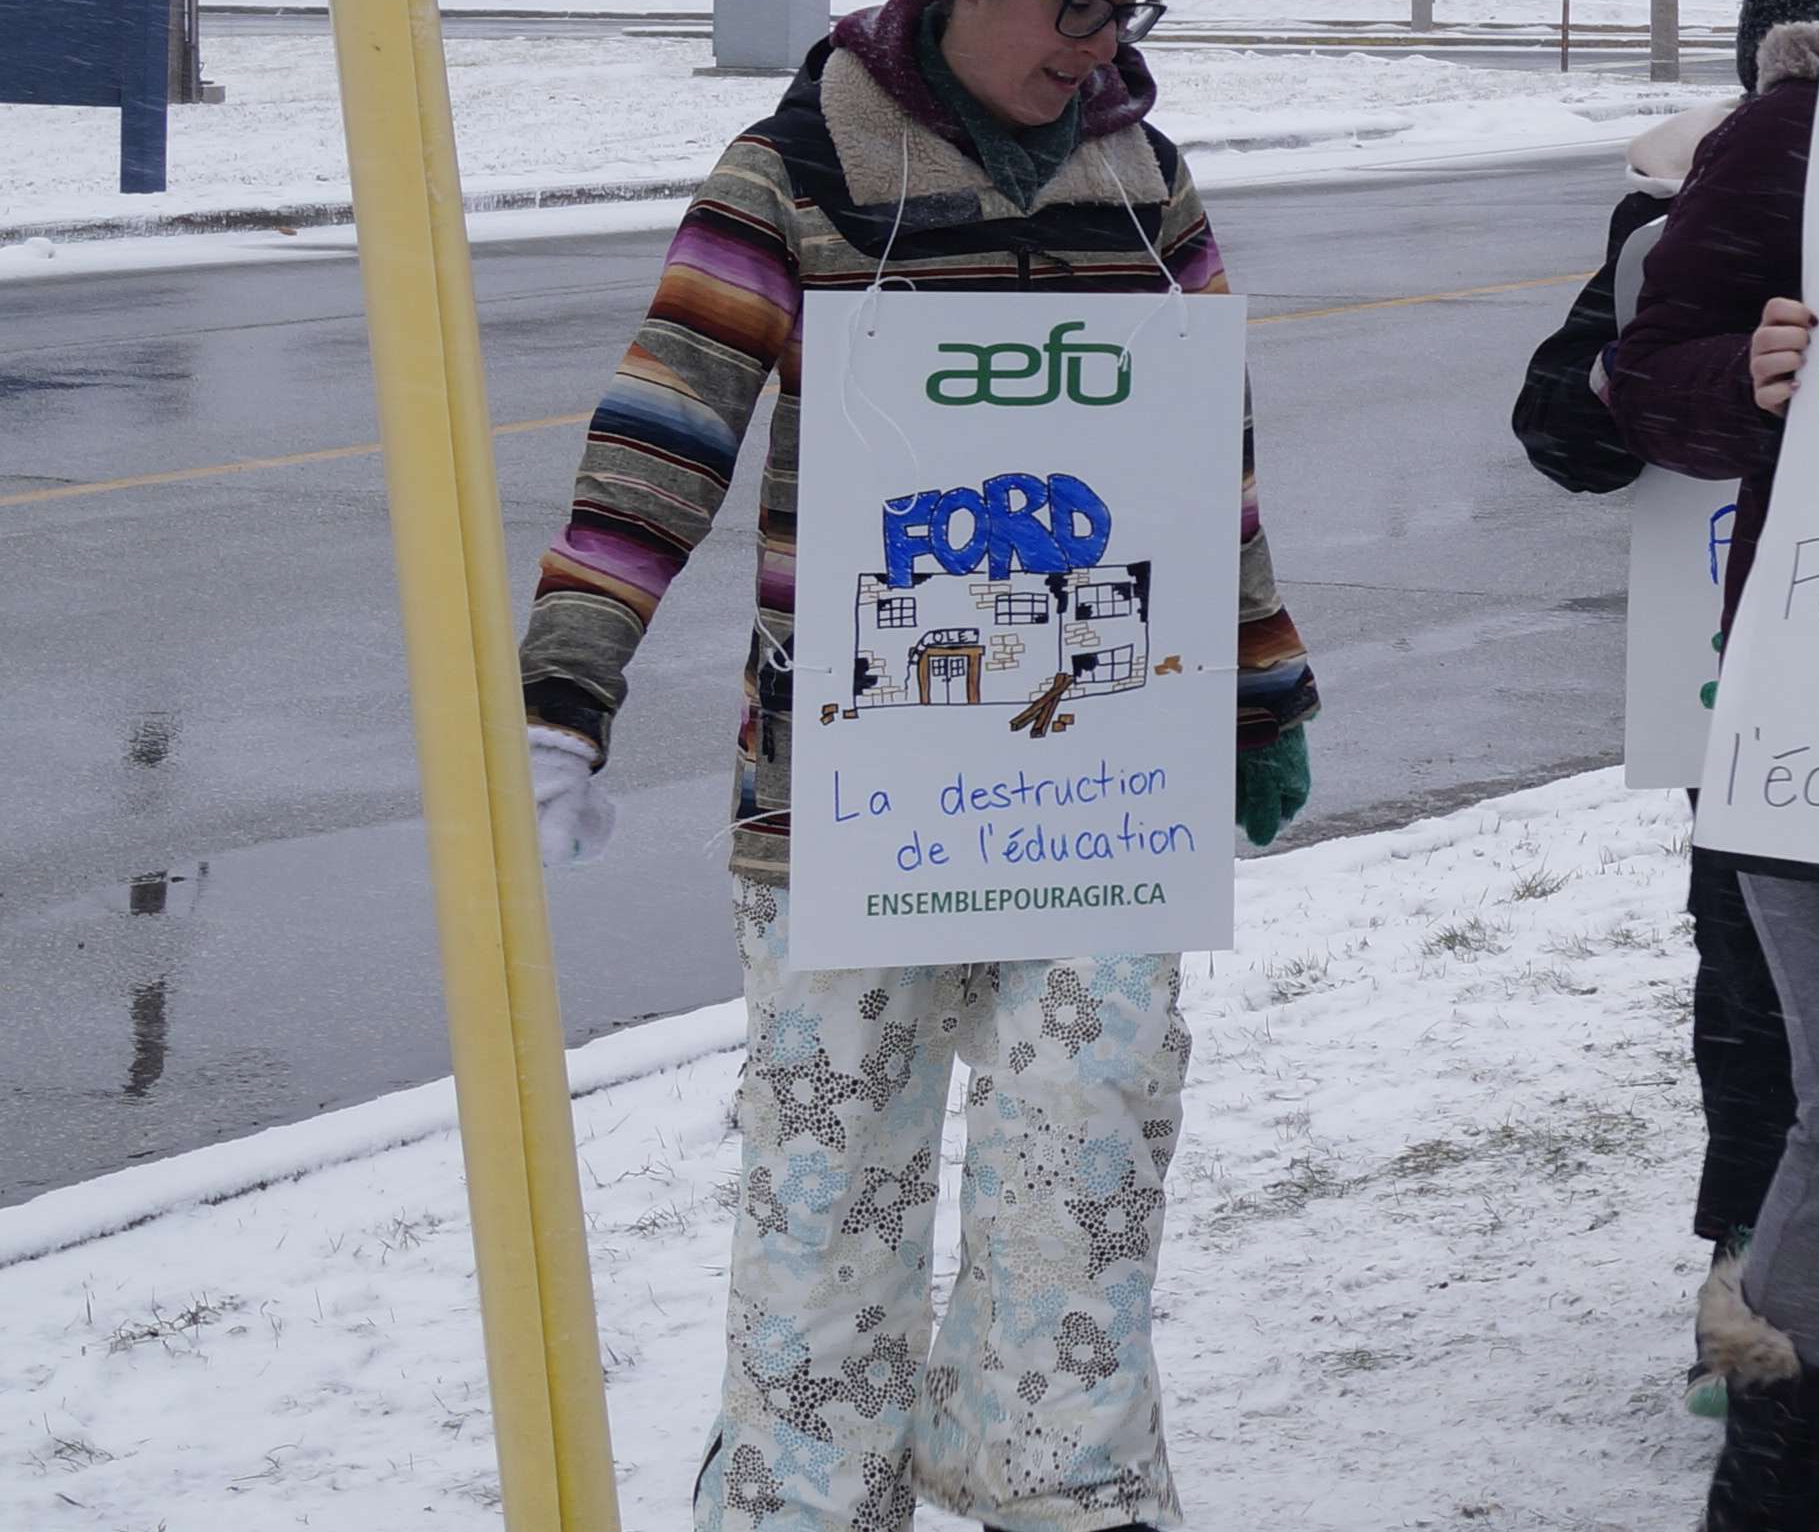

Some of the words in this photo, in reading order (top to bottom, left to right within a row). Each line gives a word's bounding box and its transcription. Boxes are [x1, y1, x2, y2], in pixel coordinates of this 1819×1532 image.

[883, 472, 1112, 587] FORD
[835, 770, 892, 821] La
[941, 759, 1166, 815] destruction
[897, 831, 950, 871] de
[980, 813, 1195, 863] l'éducation
[867, 883, 1167, 917] ENSEMBLEPOURAGIR.CA
